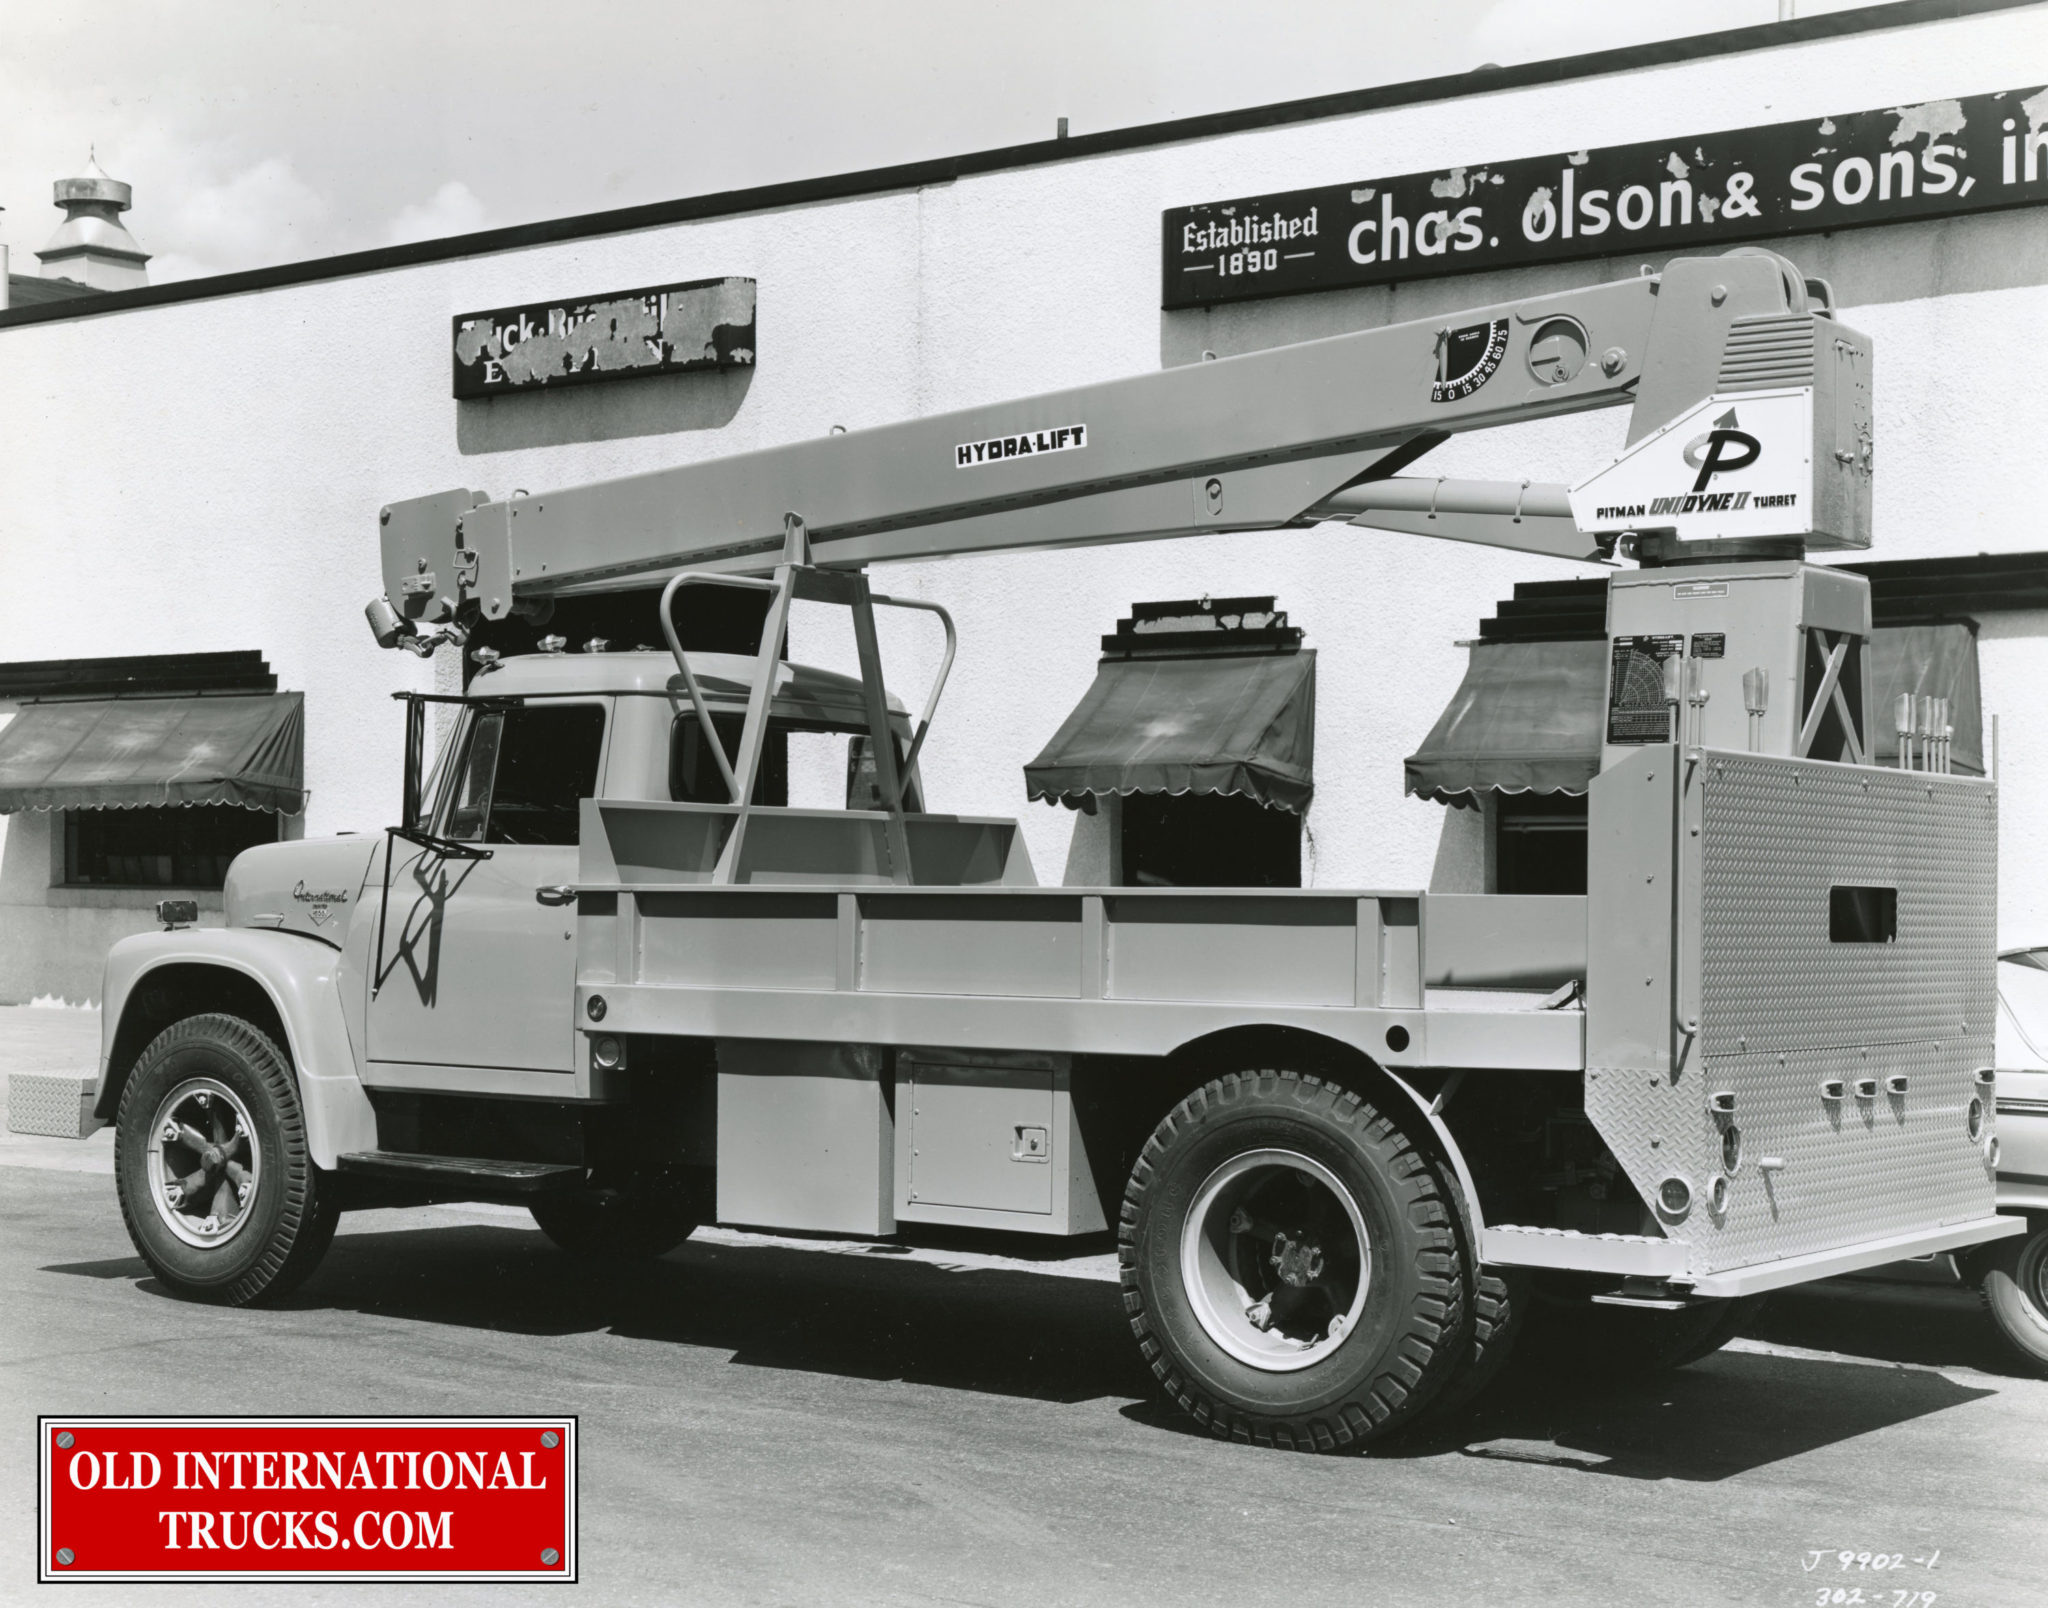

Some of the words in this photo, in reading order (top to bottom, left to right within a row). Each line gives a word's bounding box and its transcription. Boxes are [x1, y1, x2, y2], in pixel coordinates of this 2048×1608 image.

[1348, 193, 1499, 265] chas.
[1522, 168, 1693, 243] olson
[1721, 171, 1762, 219] &
[1790, 144, 1976, 211] sons,
[1182, 206, 1319, 254] Established
[1218, 248, 1278, 277] 1890
[1497, 329, 1508, 342] 75
[1492, 346, 1504, 360] 60
[1484, 361, 1496, 374] 45
[1473, 374, 1487, 387] 30
[1434, 390, 1442, 401] 15
[1448, 389, 1456, 400] 0
[1463, 384, 1473, 395] 15
[1596, 504, 1646, 519] PITMAN
[1753, 494, 1797, 508] TURRET
